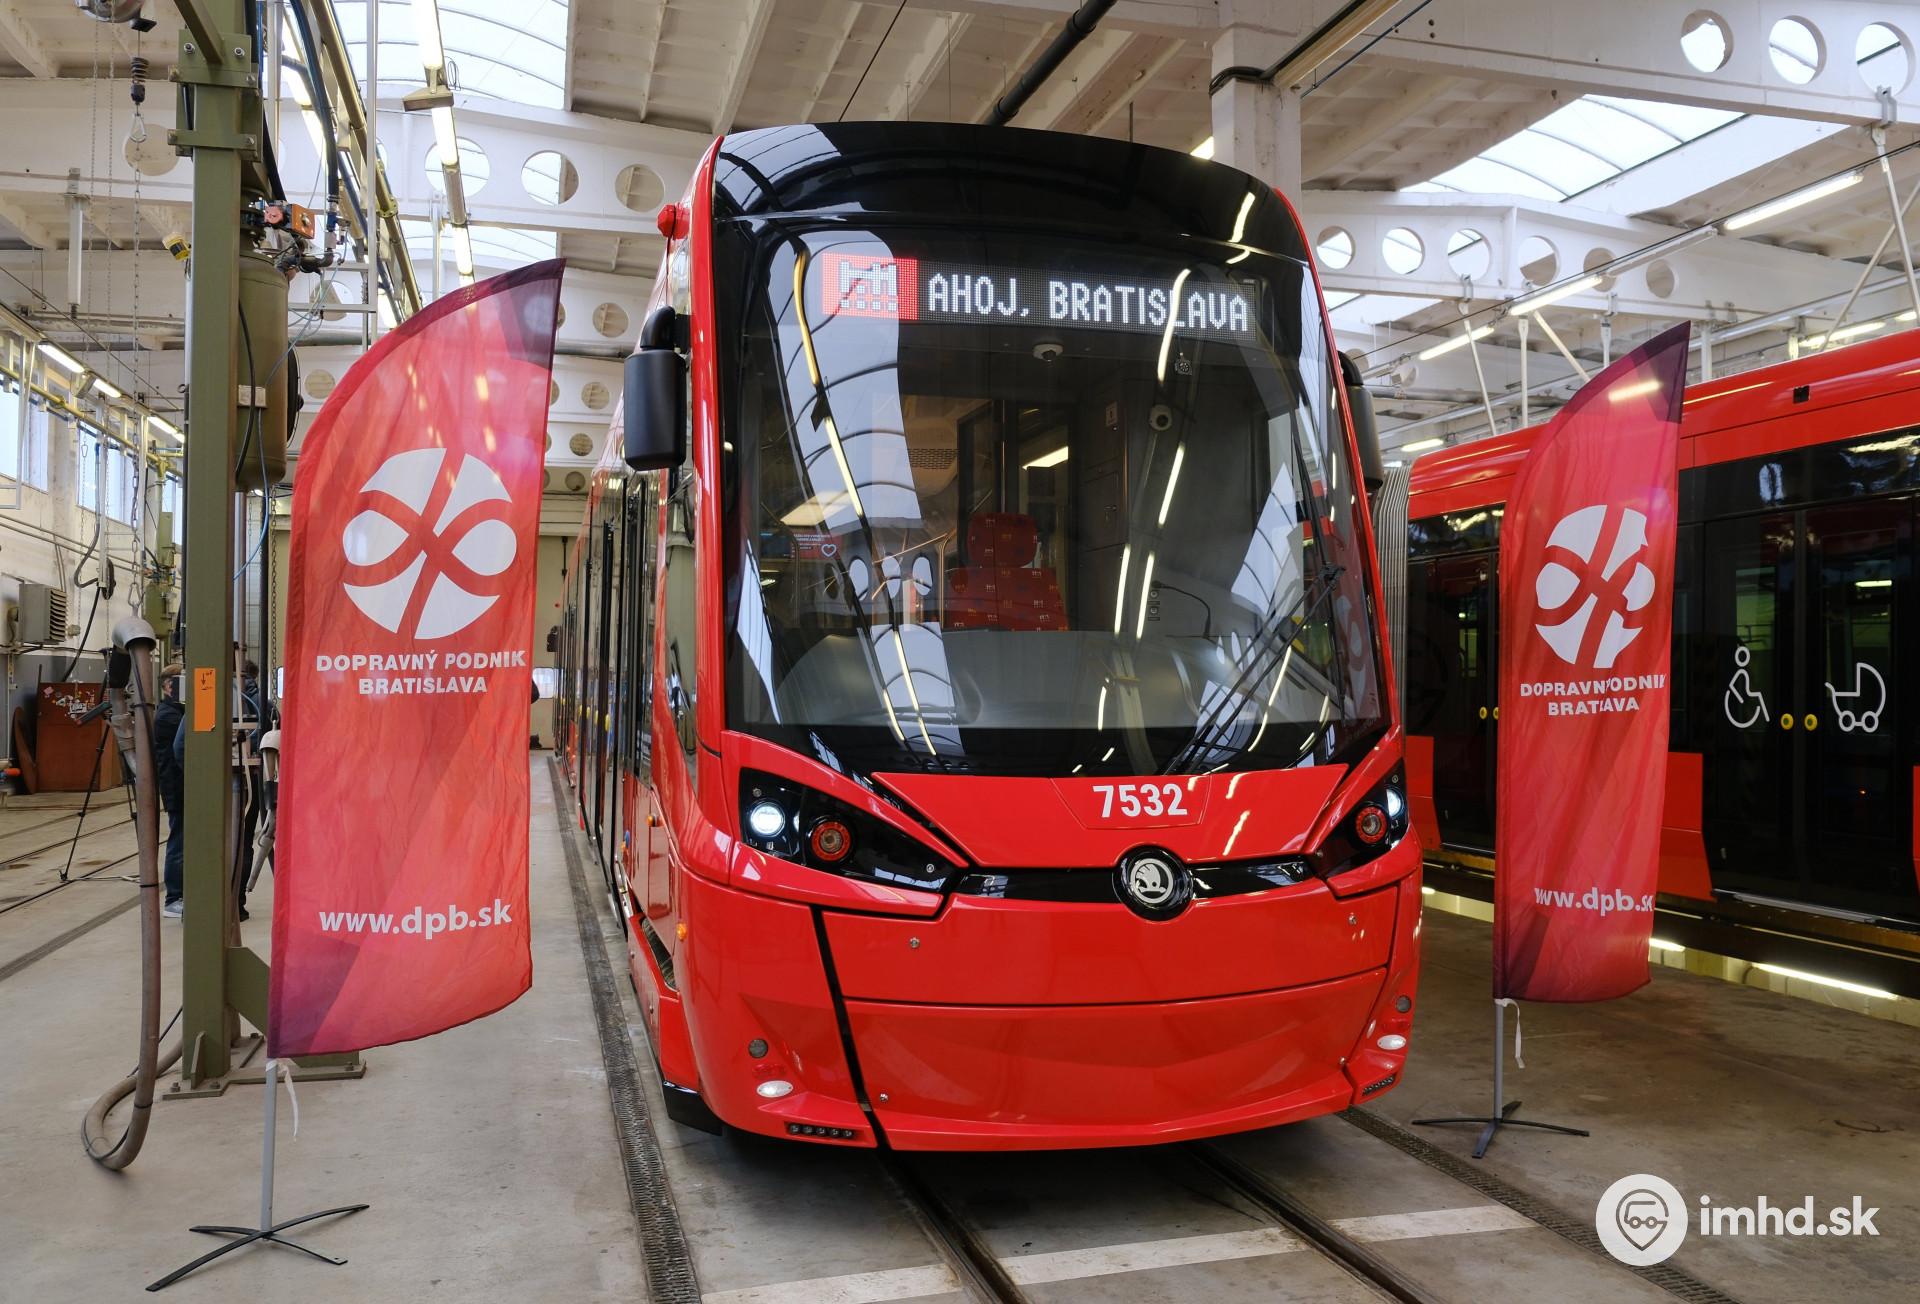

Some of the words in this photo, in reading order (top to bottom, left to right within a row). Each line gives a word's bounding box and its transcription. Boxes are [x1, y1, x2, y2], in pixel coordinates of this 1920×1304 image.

[1049, 280, 1249, 332] BRATISLAVA
[316, 649, 438, 672] DOPRAVNÝ
[444, 650, 526, 670] PODNIK
[359, 676, 488, 695] BRATISLAVA
[1092, 783, 1188, 818] 7532
[319, 898, 513, 940] www.dpb.sk
